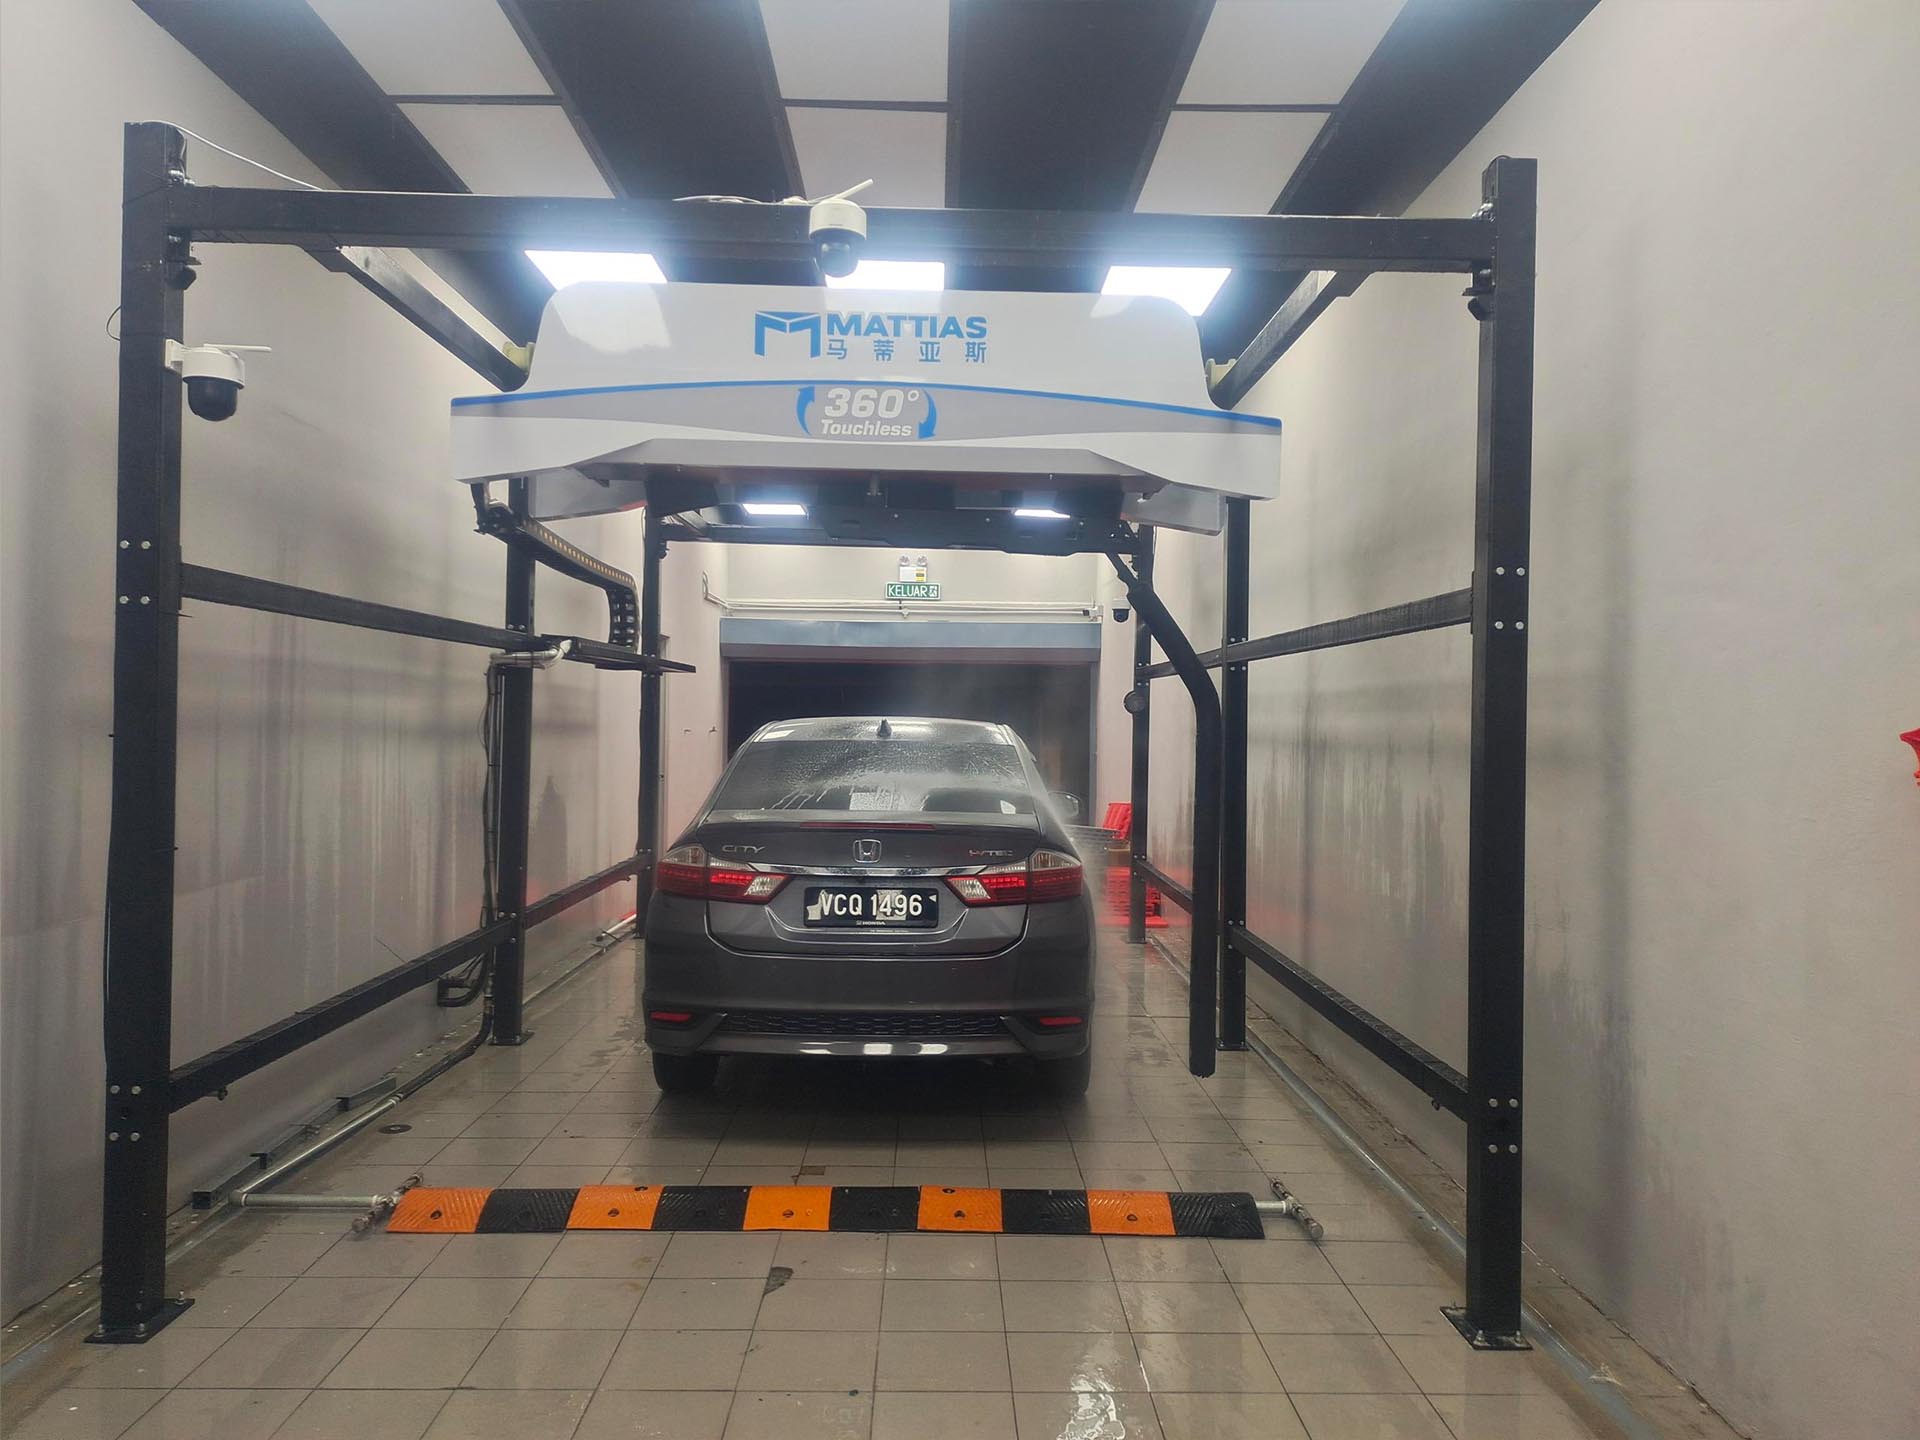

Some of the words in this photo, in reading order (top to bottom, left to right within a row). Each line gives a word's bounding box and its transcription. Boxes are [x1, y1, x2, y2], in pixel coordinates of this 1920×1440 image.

[826, 313, 987, 339] MATTIAS
[824, 387, 920, 418] 360°
[821, 419, 912, 437] Touchless
[888, 584, 927, 597] KELUAR
[722, 844, 765, 853] CITY
[821, 893, 862, 916] VCQ
[870, 893, 922, 916] 1496
